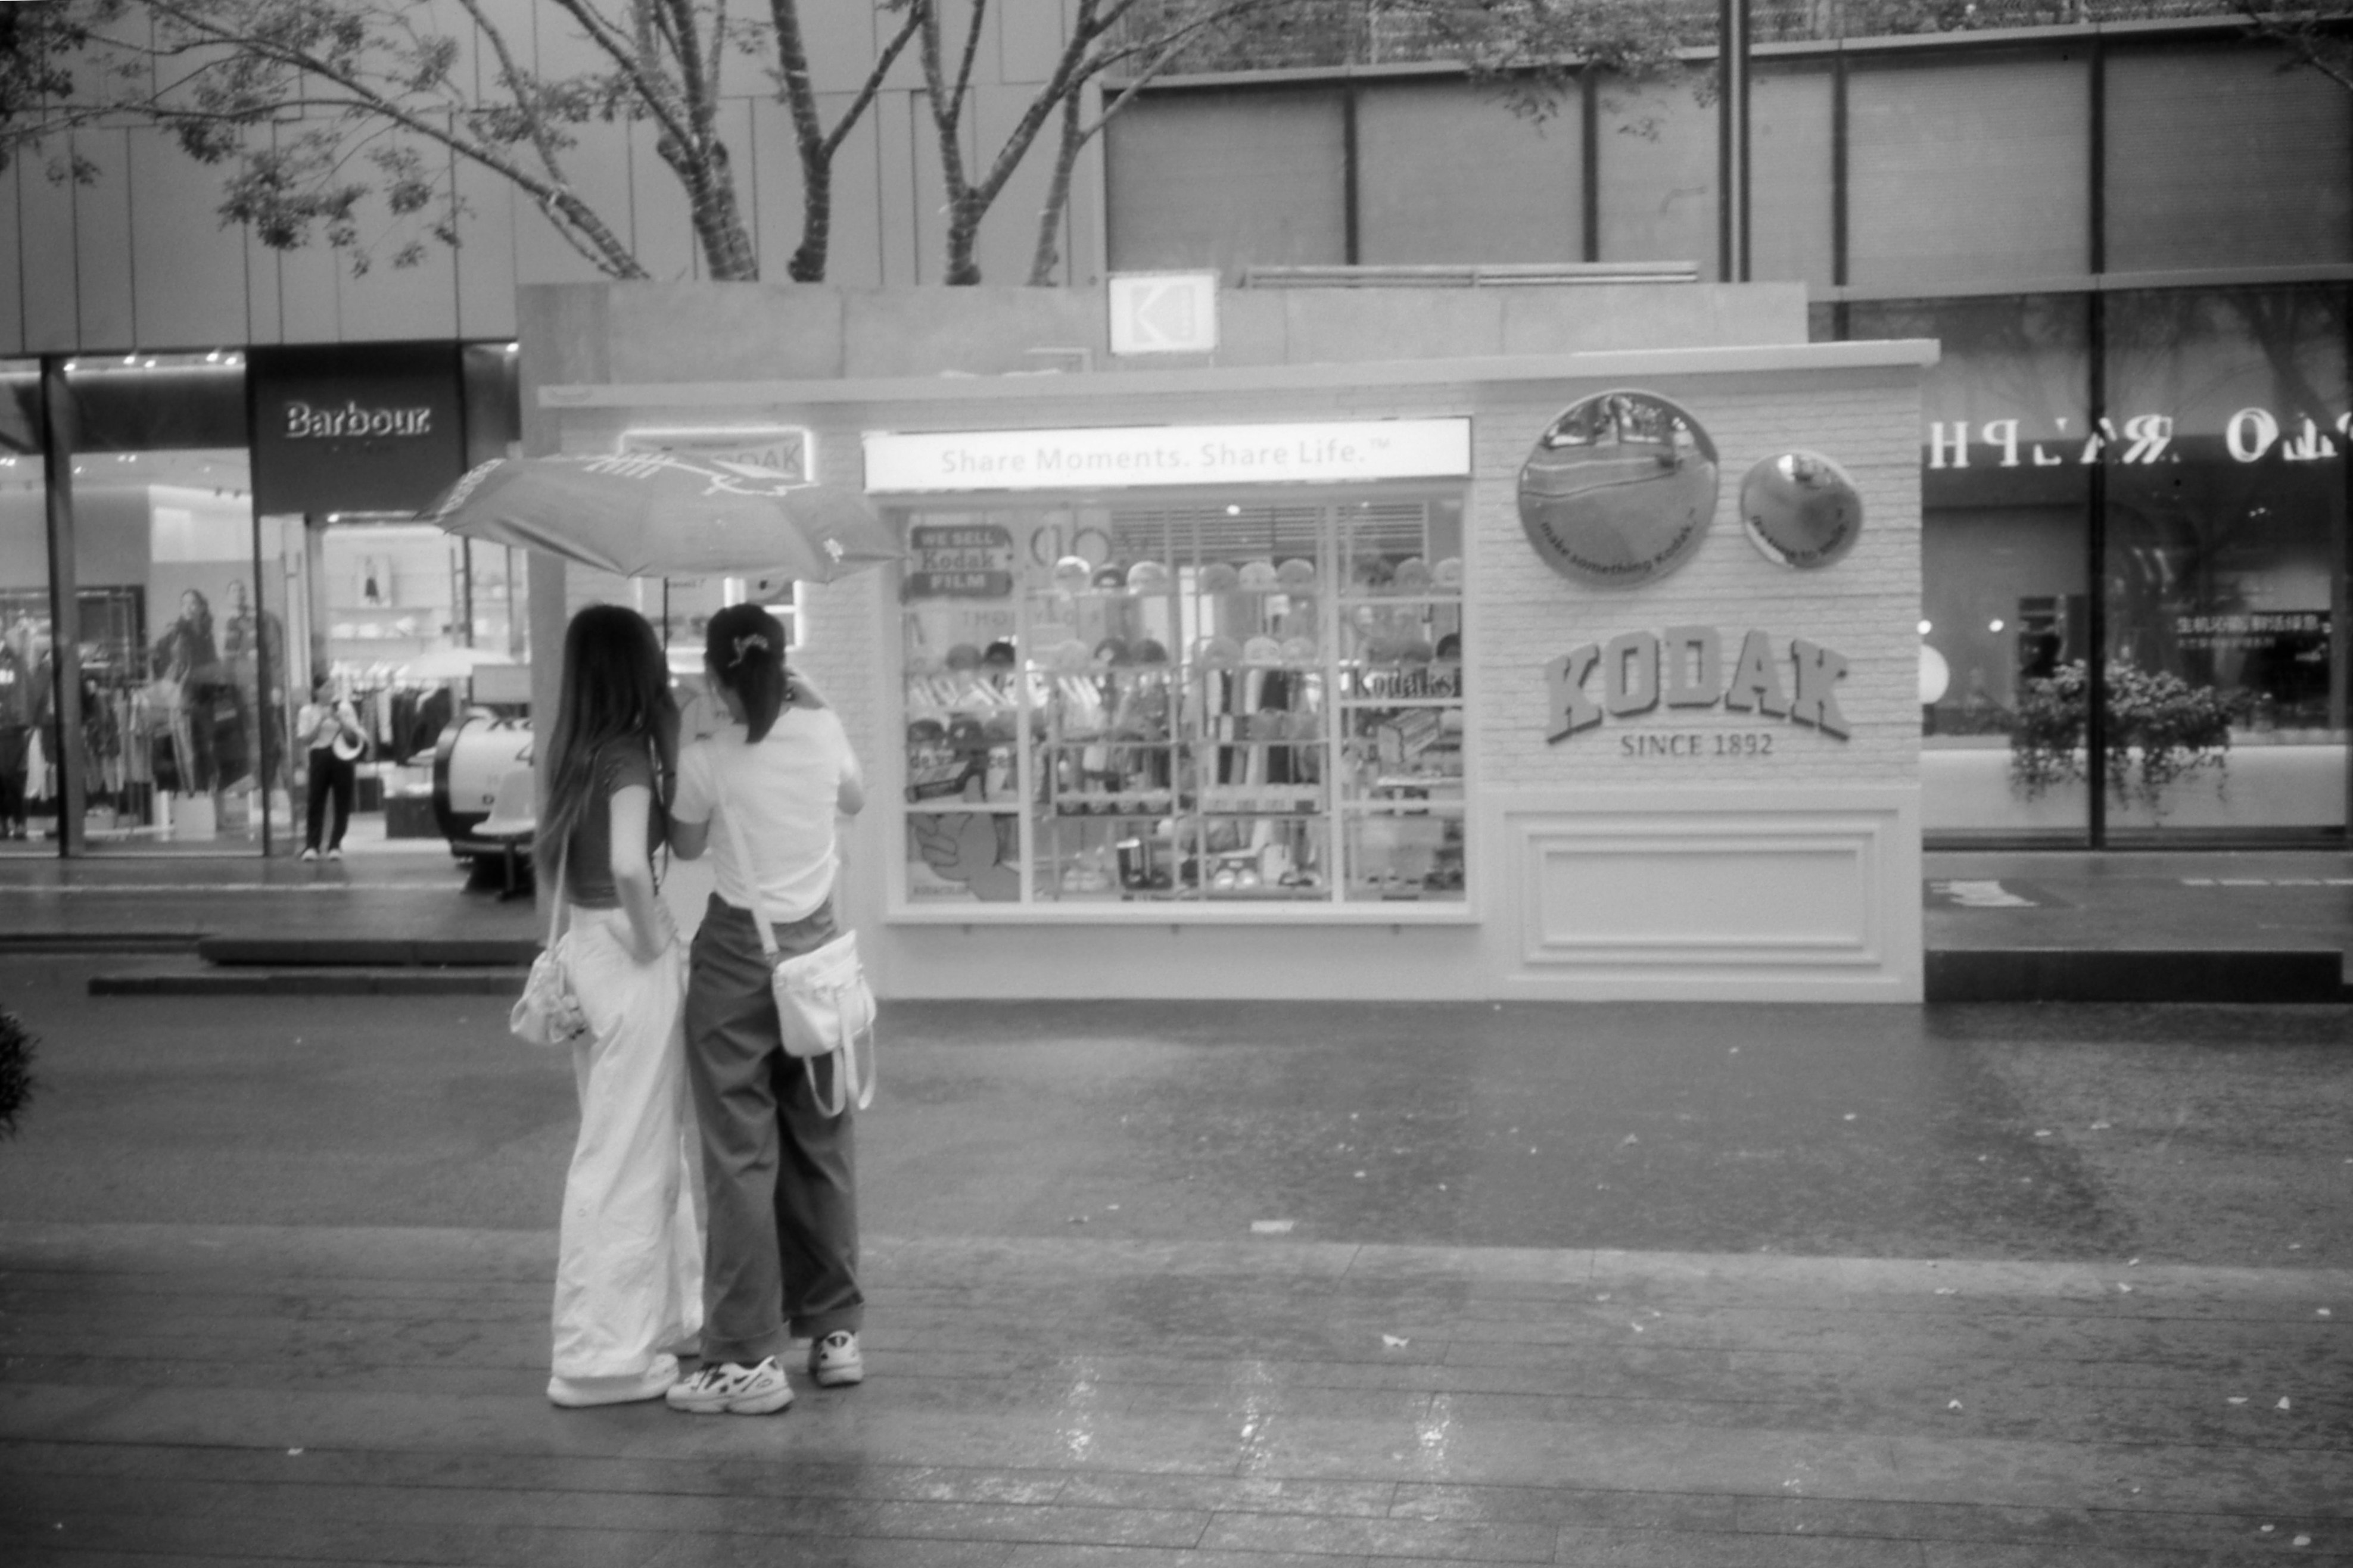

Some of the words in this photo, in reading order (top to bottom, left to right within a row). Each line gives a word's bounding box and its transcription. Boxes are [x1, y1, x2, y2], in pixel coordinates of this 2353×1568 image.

[283, 400, 432, 438] Barbour
[941, 448, 1026, 473] Share
[1037, 447, 1190, 471] Moments.
[1201, 443, 1288, 467] Share
[922, 550, 994, 569] Kodak
[930, 573, 985, 589] FILM
[1546, 624, 1850, 745] KODAK
[1620, 734, 1702, 757] SINCE
[1714, 733, 1773, 756] 1892
